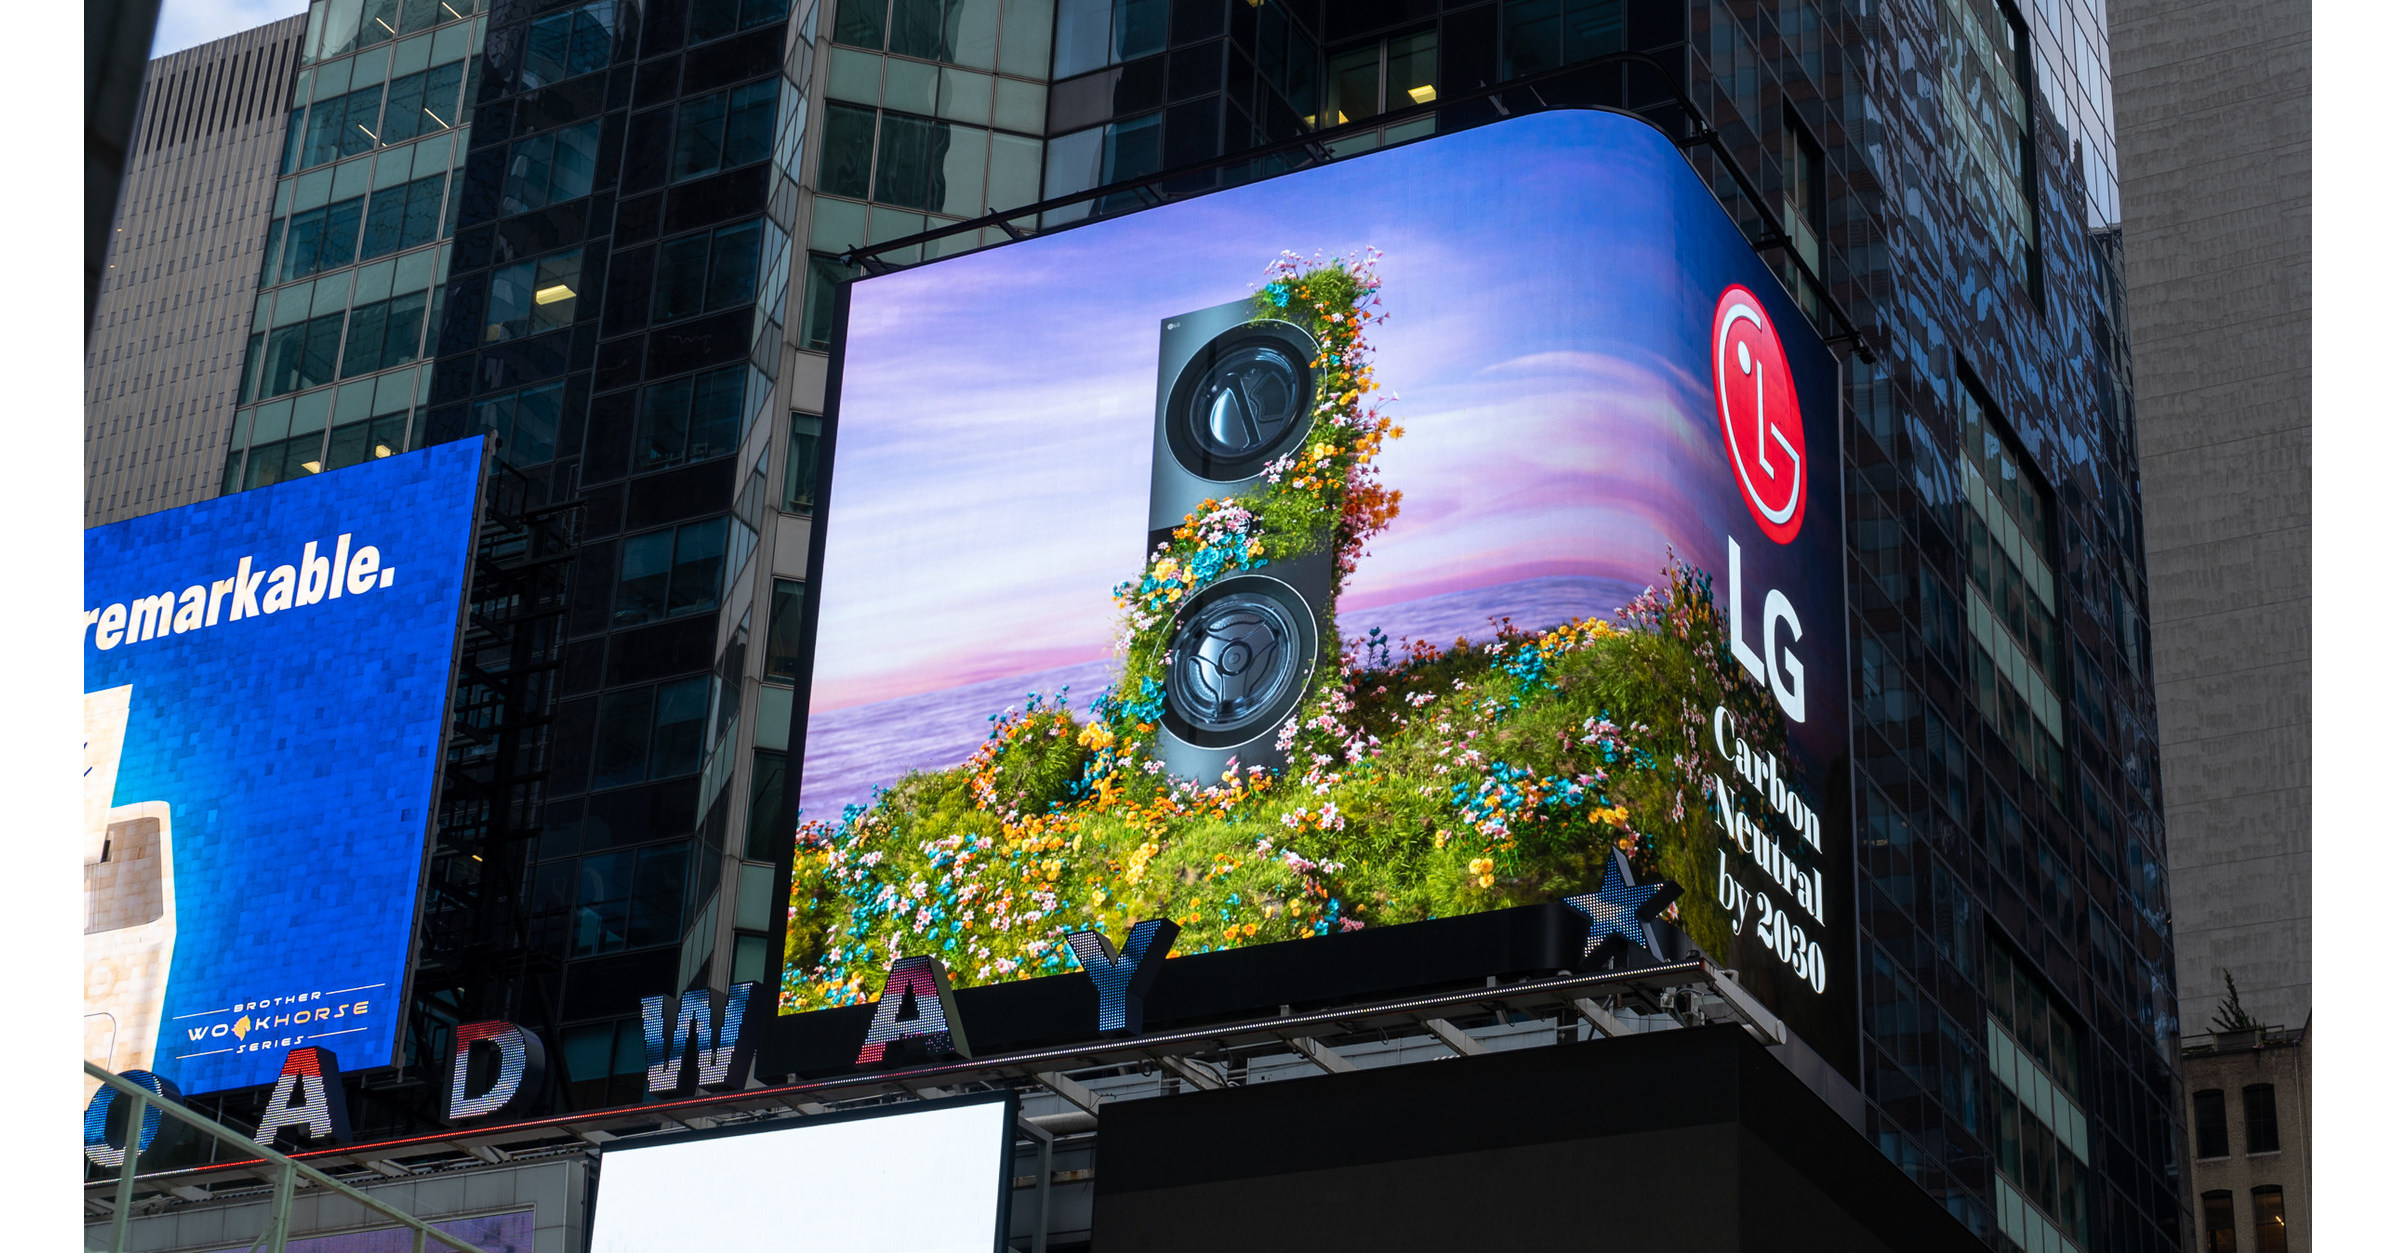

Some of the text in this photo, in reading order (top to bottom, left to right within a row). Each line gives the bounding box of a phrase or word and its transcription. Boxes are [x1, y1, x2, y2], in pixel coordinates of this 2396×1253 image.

[84, 533, 395, 651] remarkable.
[1728, 536, 1805, 723] LG
[1714, 705, 1822, 854] Carbon
[1714, 773, 1825, 927] Neutral
[1718, 848, 1826, 994] by 2030
[188, 1001, 369, 1041] WOKHORSE
[234, 991, 321, 1012] BROTHER
[237, 1035, 304, 1053] SERIES
